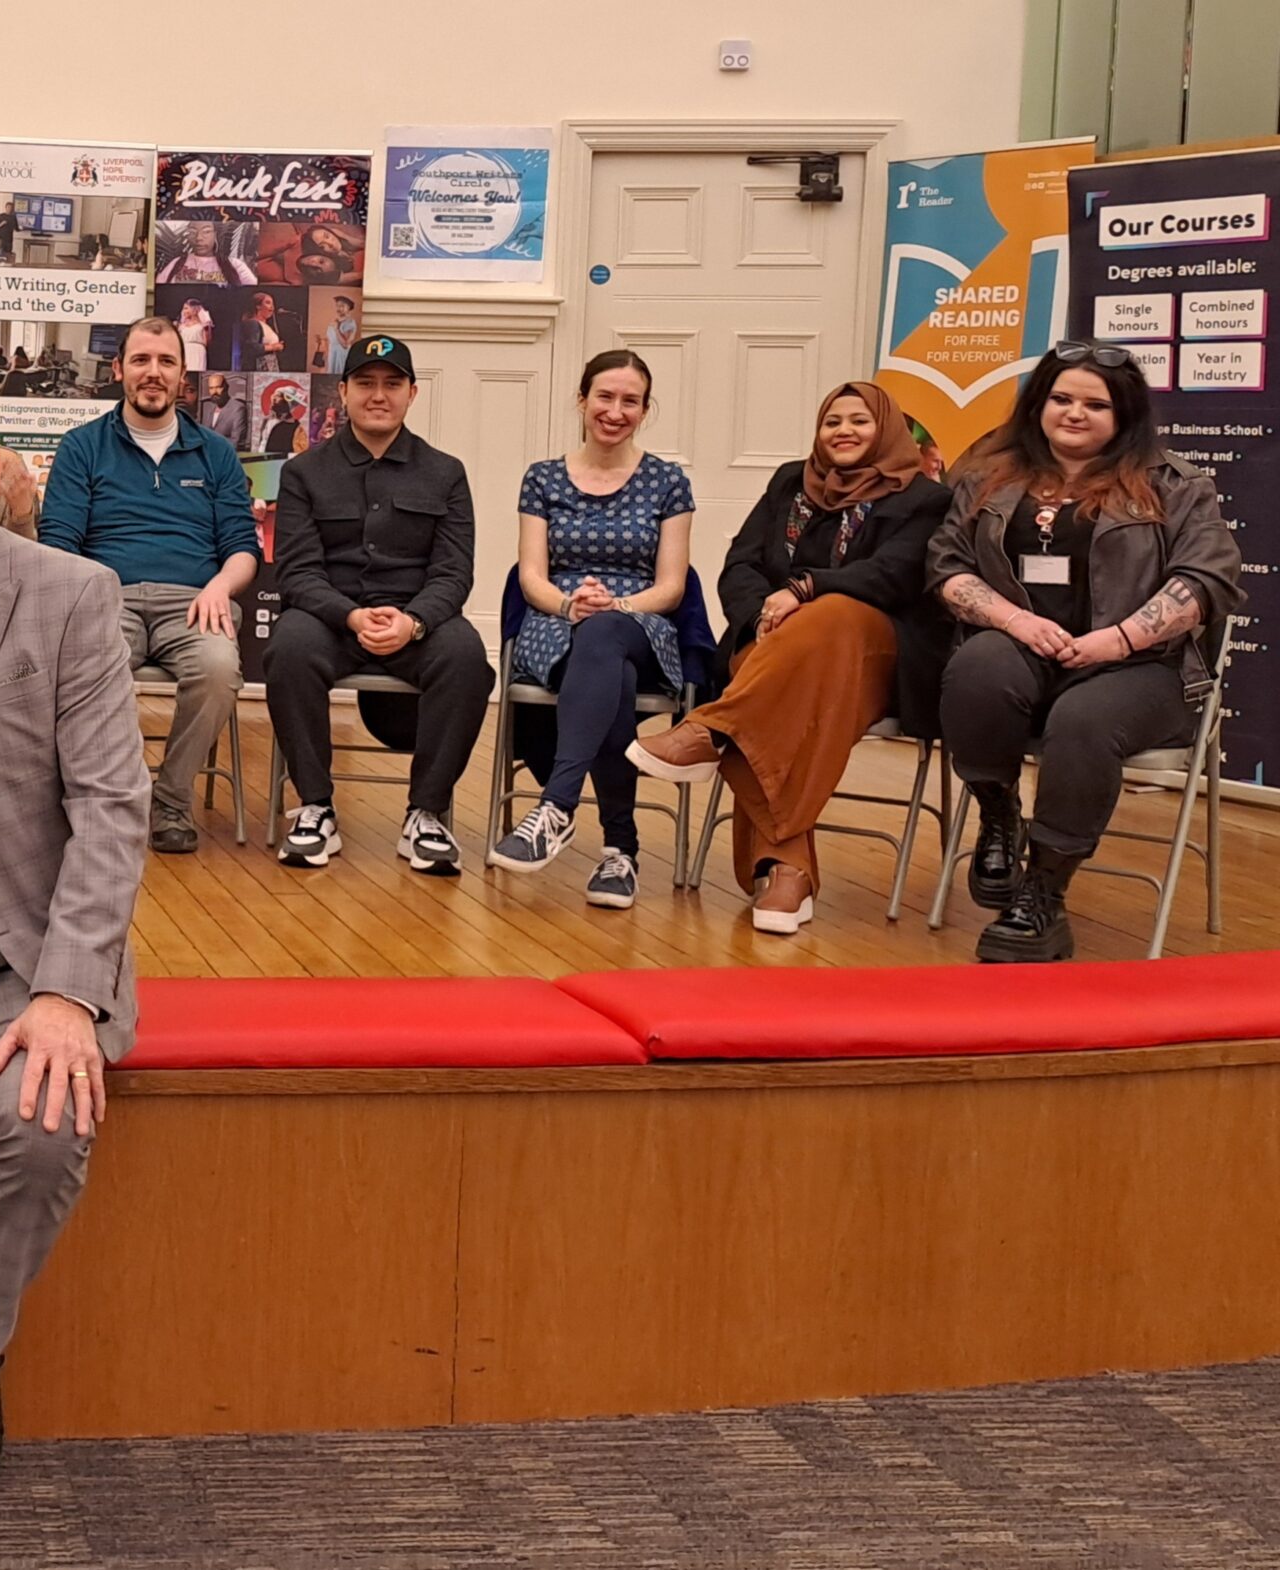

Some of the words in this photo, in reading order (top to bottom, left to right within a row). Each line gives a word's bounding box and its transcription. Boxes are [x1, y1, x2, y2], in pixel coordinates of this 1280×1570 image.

[103, 158, 144, 167] LIVERPOOL
[103, 167, 124, 175] HOPE
[412, 169, 471, 180] Southport
[103, 175, 146, 184] UNIVERSITY
[450, 179, 491, 188] Circle
[919, 186, 939, 196] The
[408, 189, 479, 204] Welcomes
[484, 190, 522, 206] You!
[918, 196, 954, 207] Reader
[1108, 218, 1154, 237] Our
[1160, 213, 1256, 234] Courses
[1107, 264, 1174, 283] Degrees
[1177, 258, 1257, 277] available:
[4, 276, 71, 296] Writing,
[74, 279, 137, 296] Gender
[935, 285, 1020, 306] SHARED
[1114, 303, 1152, 318] Single
[1189, 299, 1255, 313] Combined
[928, 309, 1020, 329] READING
[1195, 318, 1248, 330] honours
[1108, 320, 1159, 332] honours
[944, 335, 968, 346] FOR
[969, 334, 1000, 346] FREE
[926, 351, 950, 362] FOR
[951, 350, 1015, 362] EVERYONE
[1131, 354, 1166, 365] ation
[1197, 352, 1226, 364] Year
[1230, 352, 1242, 363] in
[1193, 369, 1247, 383] Industry
[1172, 423, 1222, 436] Business
[1223, 424, 1264, 436] School
[1212, 450, 1234, 461] and
[1240, 563, 1269, 574] nces
[1226, 640, 1259, 652] puter
